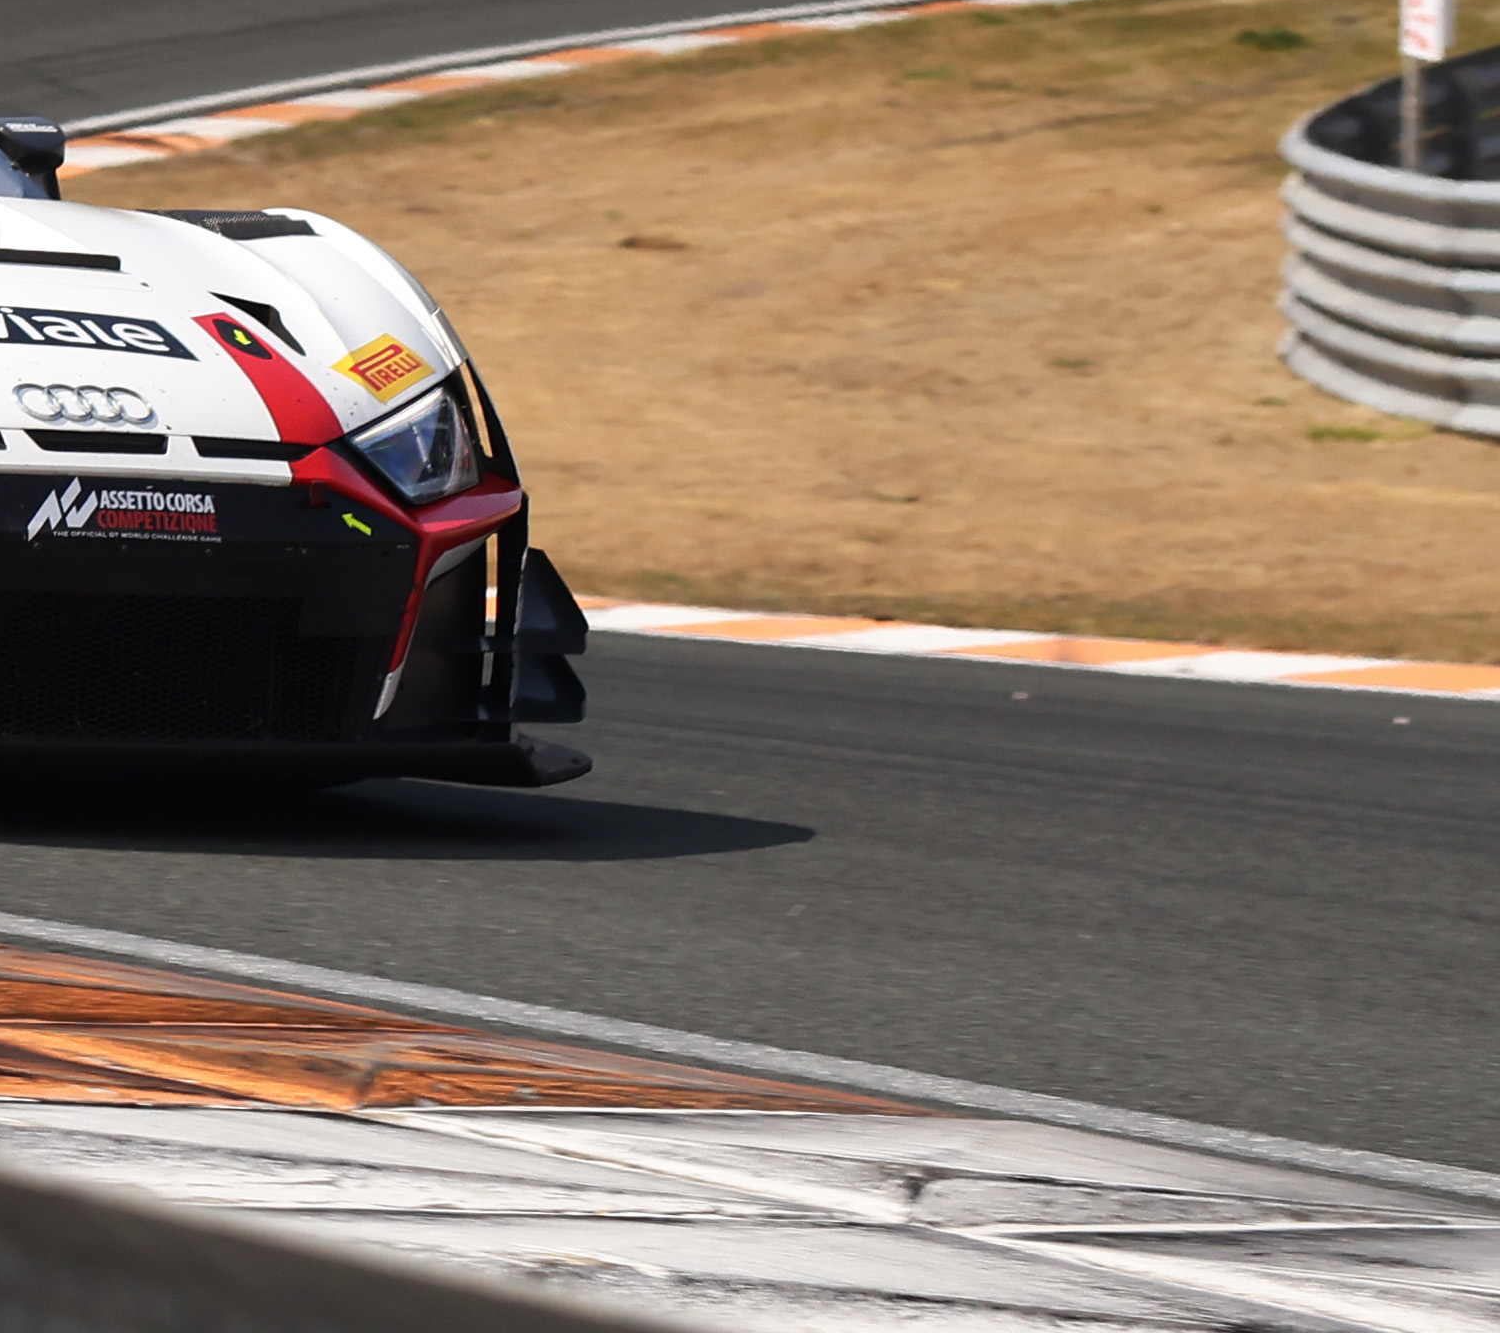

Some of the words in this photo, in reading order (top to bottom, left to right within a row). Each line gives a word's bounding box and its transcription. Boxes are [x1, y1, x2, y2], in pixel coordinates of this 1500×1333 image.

[349, 343, 423, 393] PIRELLI
[100, 490, 165, 511] ASSETTO
[165, 493, 215, 514] CORSA
[97, 510, 218, 532] COMPETIZIONE
